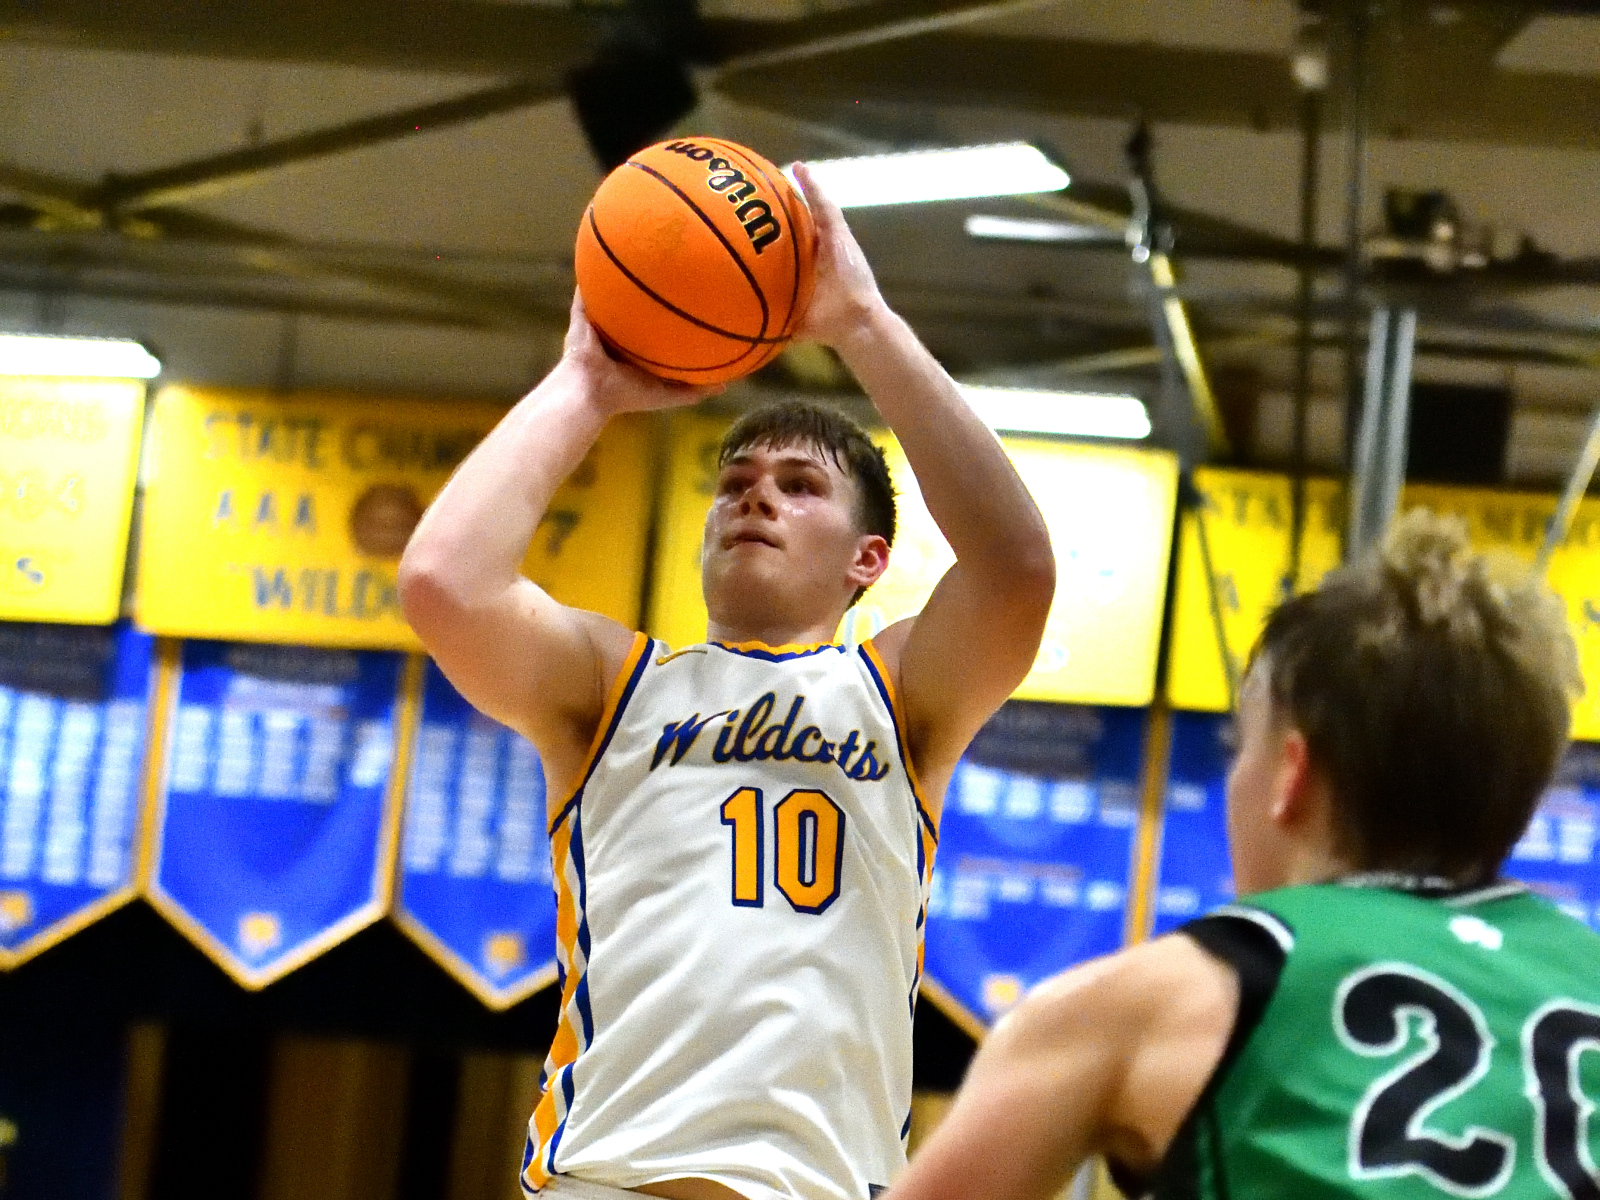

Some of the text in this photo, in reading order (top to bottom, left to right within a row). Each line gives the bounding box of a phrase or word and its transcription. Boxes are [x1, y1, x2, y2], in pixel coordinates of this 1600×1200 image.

[663, 140, 782, 256] Wilson
[650, 691, 893, 782] Wildcats
[719, 785, 846, 916] 10
